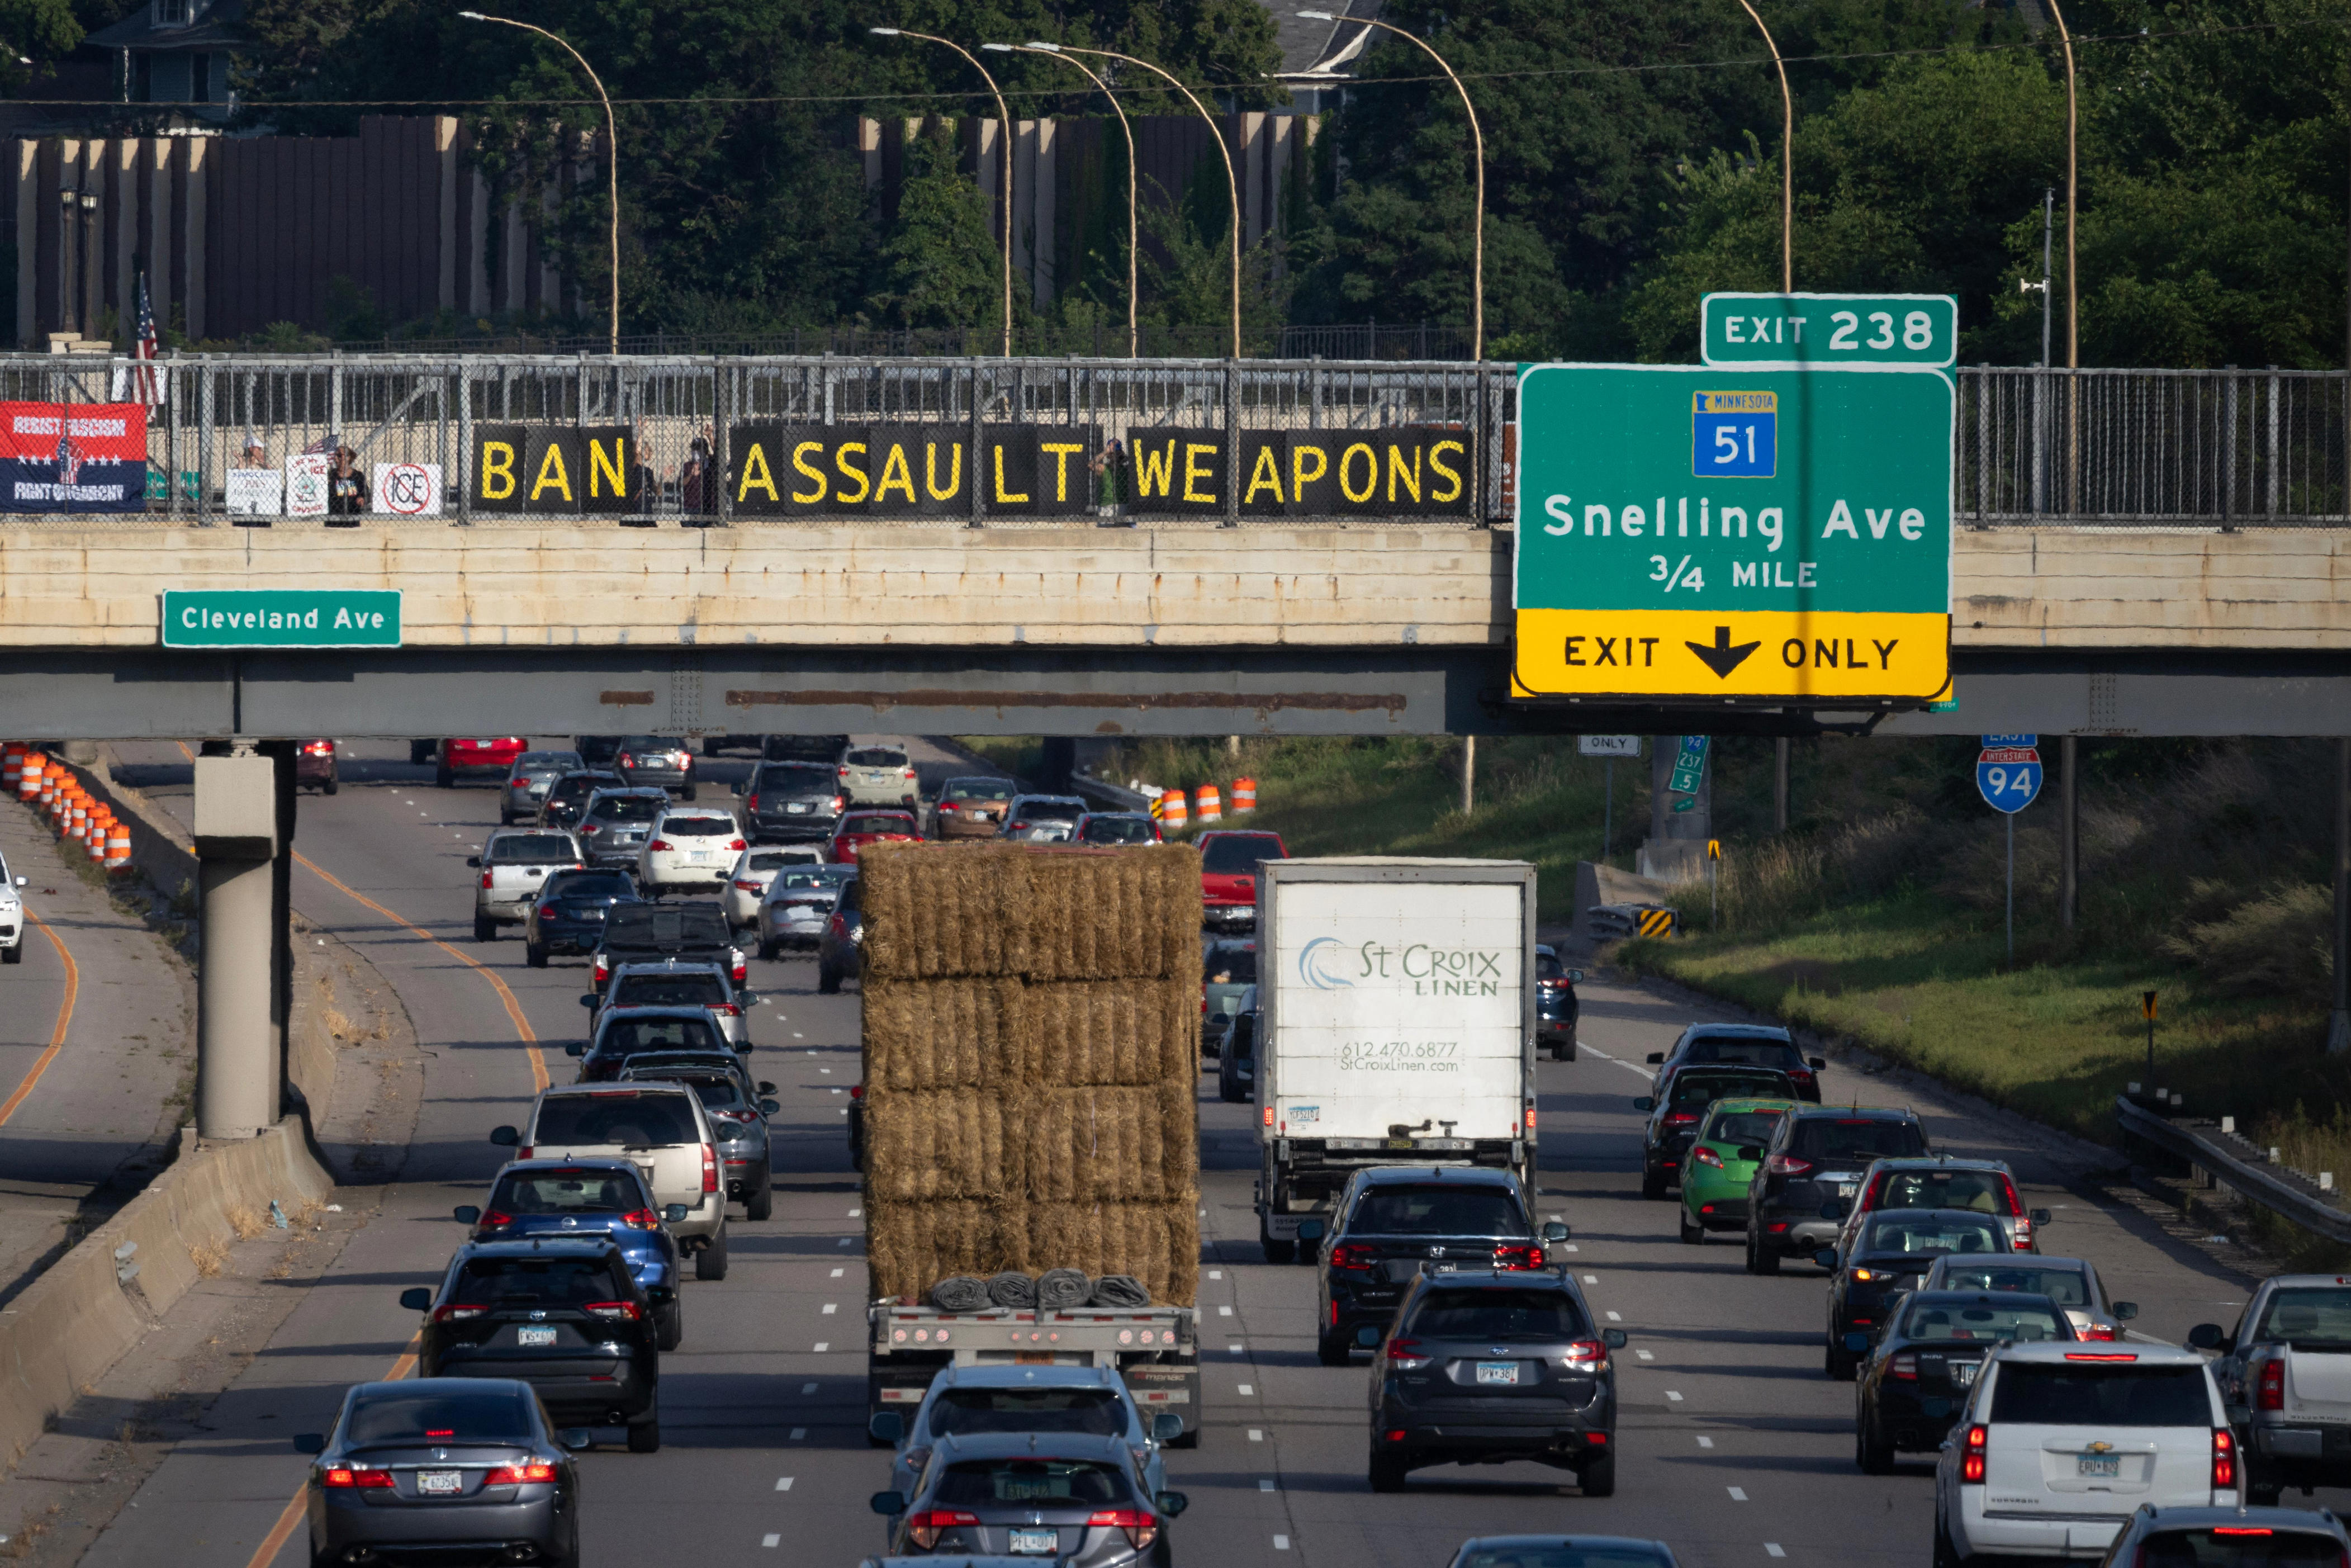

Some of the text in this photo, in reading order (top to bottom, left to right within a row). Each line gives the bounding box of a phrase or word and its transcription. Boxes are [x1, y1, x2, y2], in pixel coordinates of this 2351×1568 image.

[1726, 311, 1933, 350] EXIT 238
[1714, 395, 1774, 409] MINNESOTA
[13, 416, 126, 437] RESIST FASCISM
[1714, 425, 1755, 464] 51
[310, 465, 326, 475] ICE
[481, 438, 626, 501] BAN
[738, 441, 1083, 504] ASSAULT
[1134, 439, 1464, 504] WEAPONS
[14, 481, 52, 500] FIGHT
[391, 473, 425, 504] ICE
[1543, 494, 1926, 552] Snelling Ave
[1649, 554, 1817, 593] 3/4 MILE
[182, 607, 385, 629] Cleveland Ave
[1565, 636, 1899, 671] EXIT ONLY
[1591, 737, 1627, 749] ONLY
[1688, 736, 1701, 748] 94
[1679, 752, 1701, 768] 237
[1987, 752, 2031, 761] INTERSTATE
[1988, 767, 2032, 798] 94
[1360, 941, 1393, 978] St
[1415, 980, 1498, 996] LINEN
[1343, 1042, 1458, 1058] 612.470.6877
[1340, 1057, 1458, 1072] StCroixLinen.com
